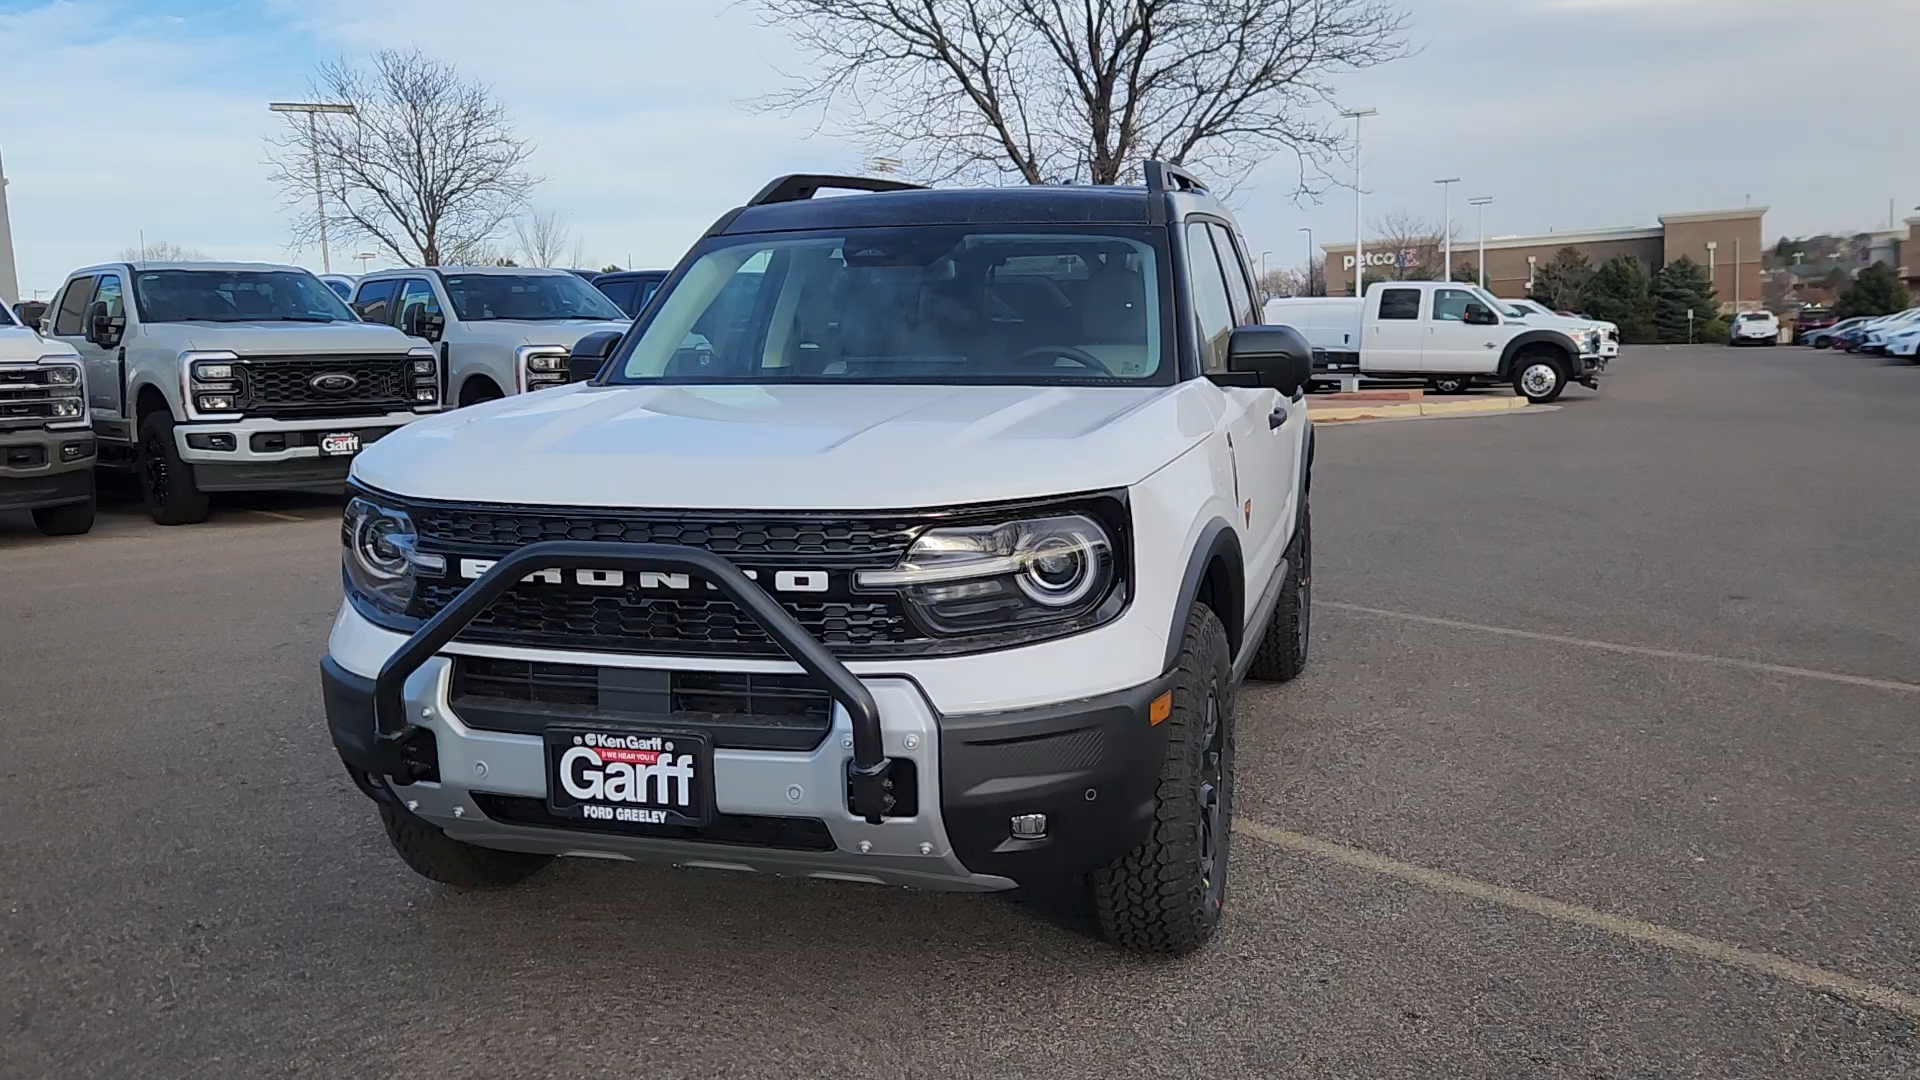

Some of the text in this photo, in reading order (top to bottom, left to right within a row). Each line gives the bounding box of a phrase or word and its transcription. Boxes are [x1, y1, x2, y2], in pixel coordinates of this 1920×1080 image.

[322, 436, 358, 452] Garff
[460, 558, 829, 592] BONO
[607, 751, 650, 761] WE HEAR YOU
[559, 746, 694, 806] Garff
[584, 805, 667, 824] FORD GREELEY
